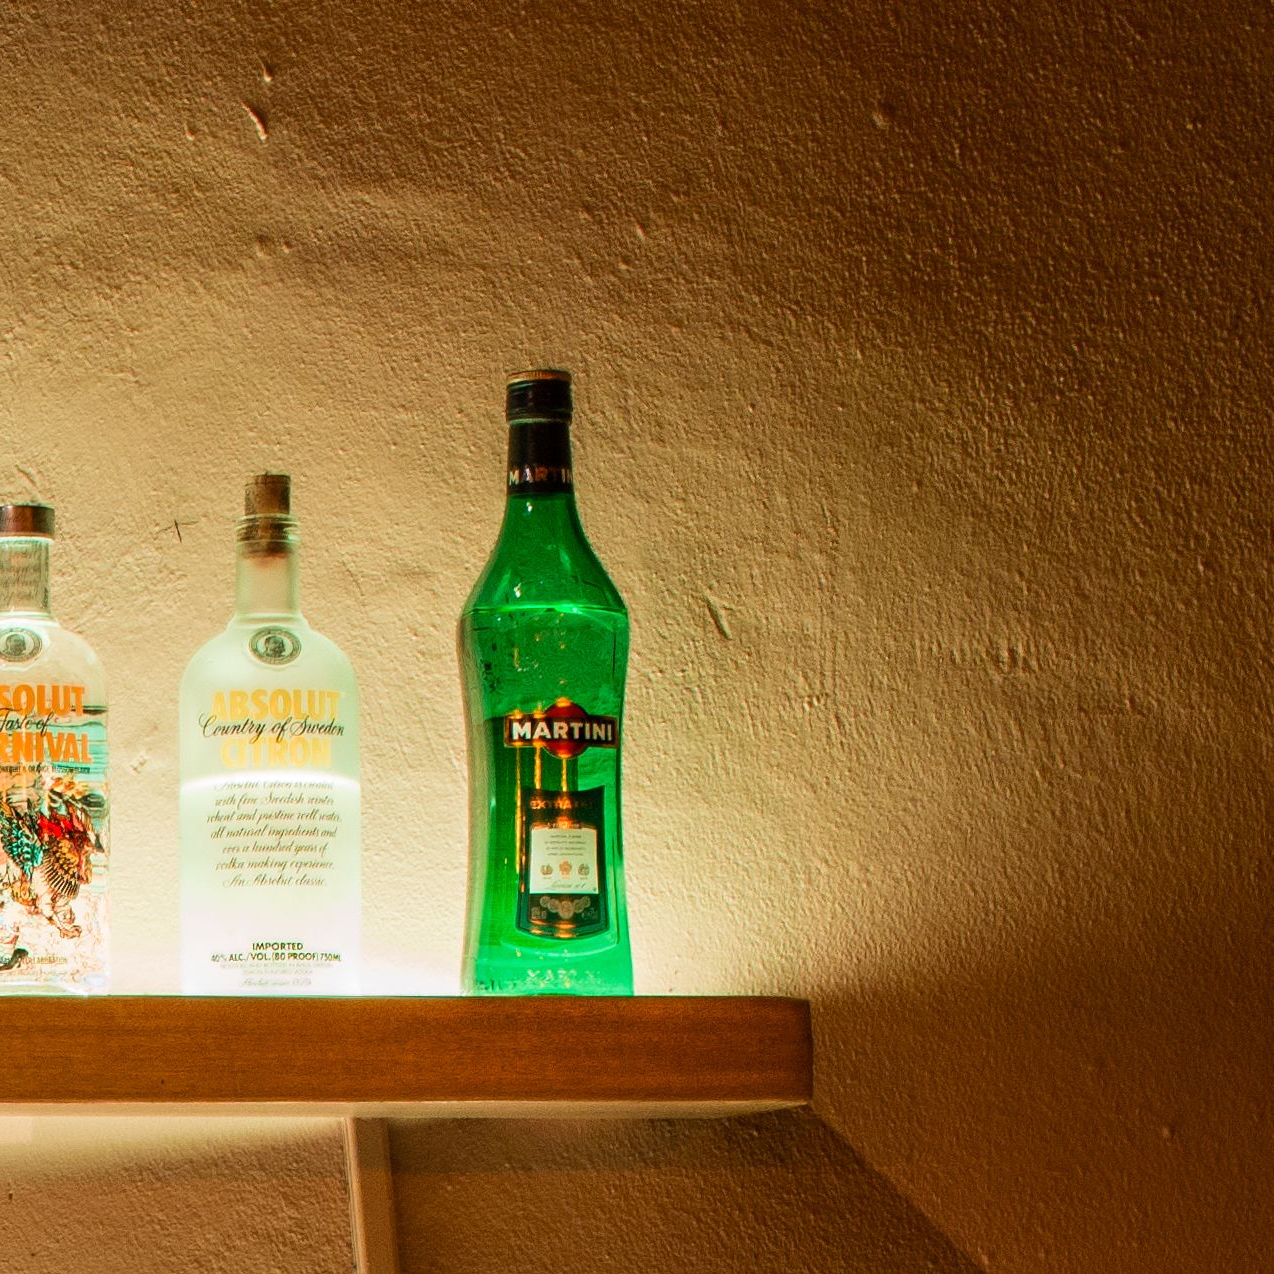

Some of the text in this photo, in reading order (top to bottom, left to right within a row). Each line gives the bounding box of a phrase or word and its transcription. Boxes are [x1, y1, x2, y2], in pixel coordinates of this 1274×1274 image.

[211, 687, 341, 721] ABSOLUT
[198, 713, 345, 745] Country of Sweden
[511, 720, 614, 742] MARTINI
[220, 737, 332, 768] CITRON
[251, 942, 304, 951] IMPORTED
